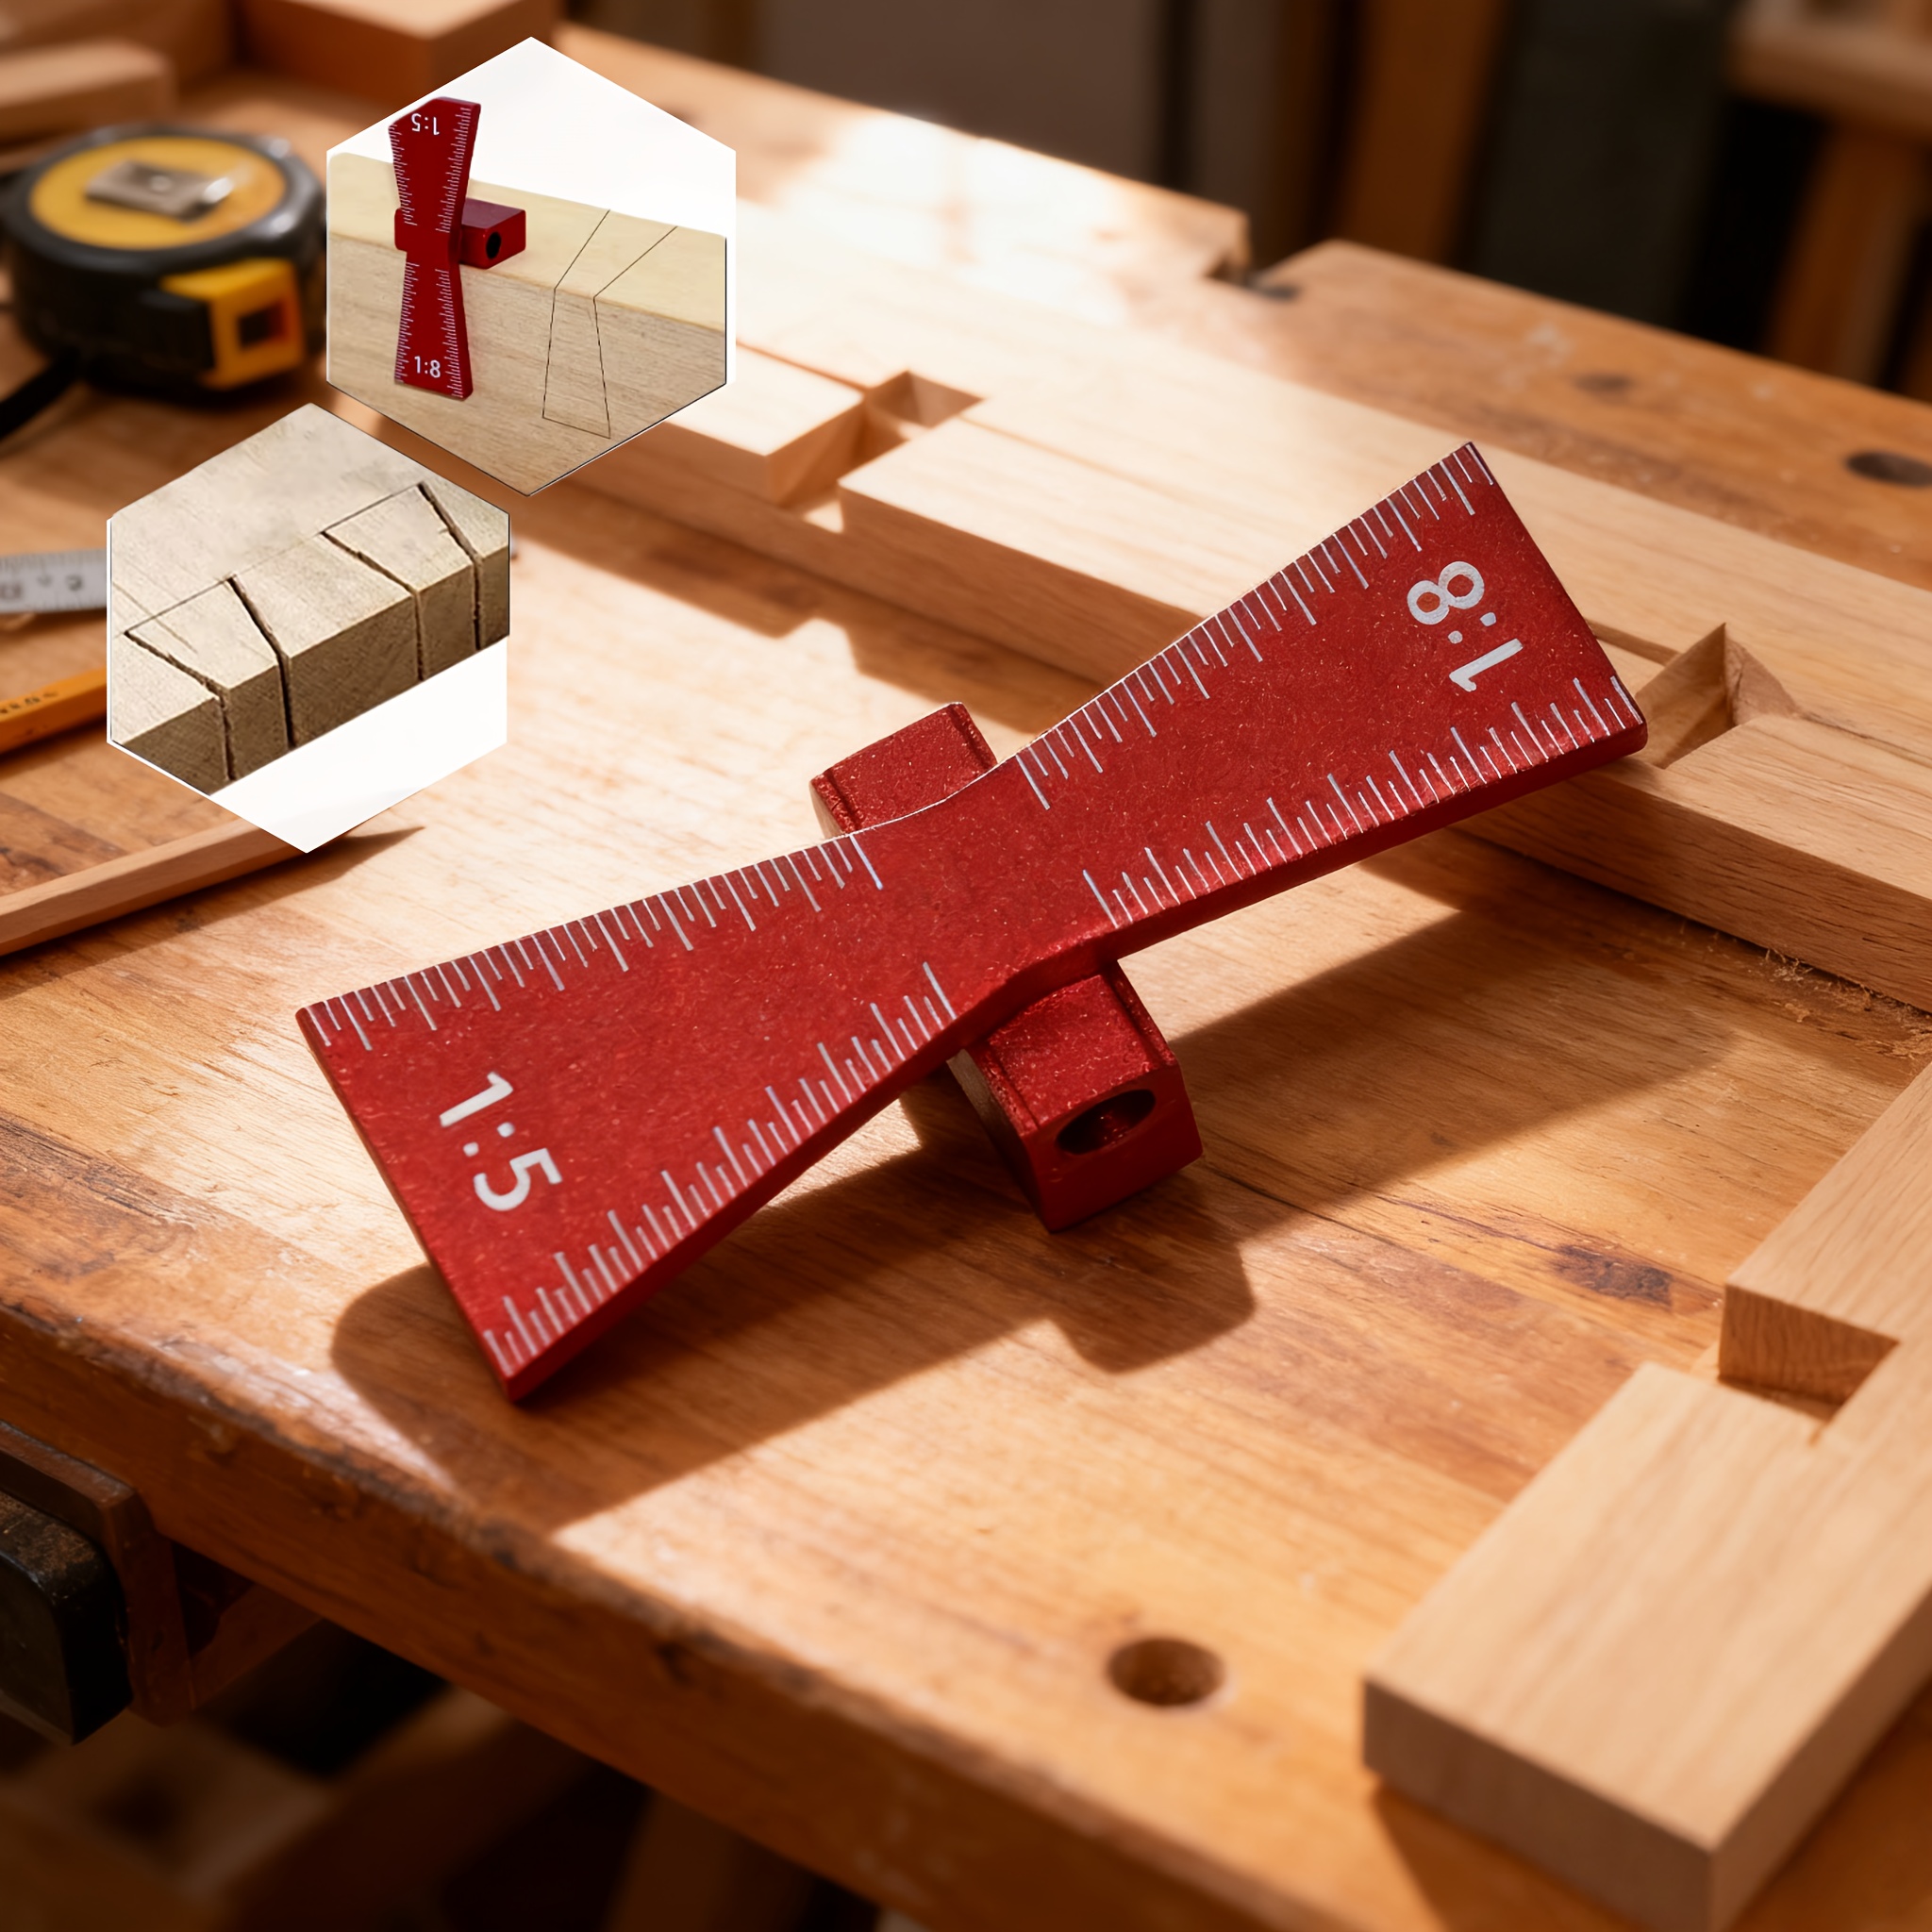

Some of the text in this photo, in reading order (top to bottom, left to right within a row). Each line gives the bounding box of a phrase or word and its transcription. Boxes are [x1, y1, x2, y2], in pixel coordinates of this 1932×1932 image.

[411, 112, 440, 136] 1:5
[414, 356, 441, 378] 1:8
[1407, 560, 1524, 692] 1:8
[439, 1071, 563, 1211] 1:5
